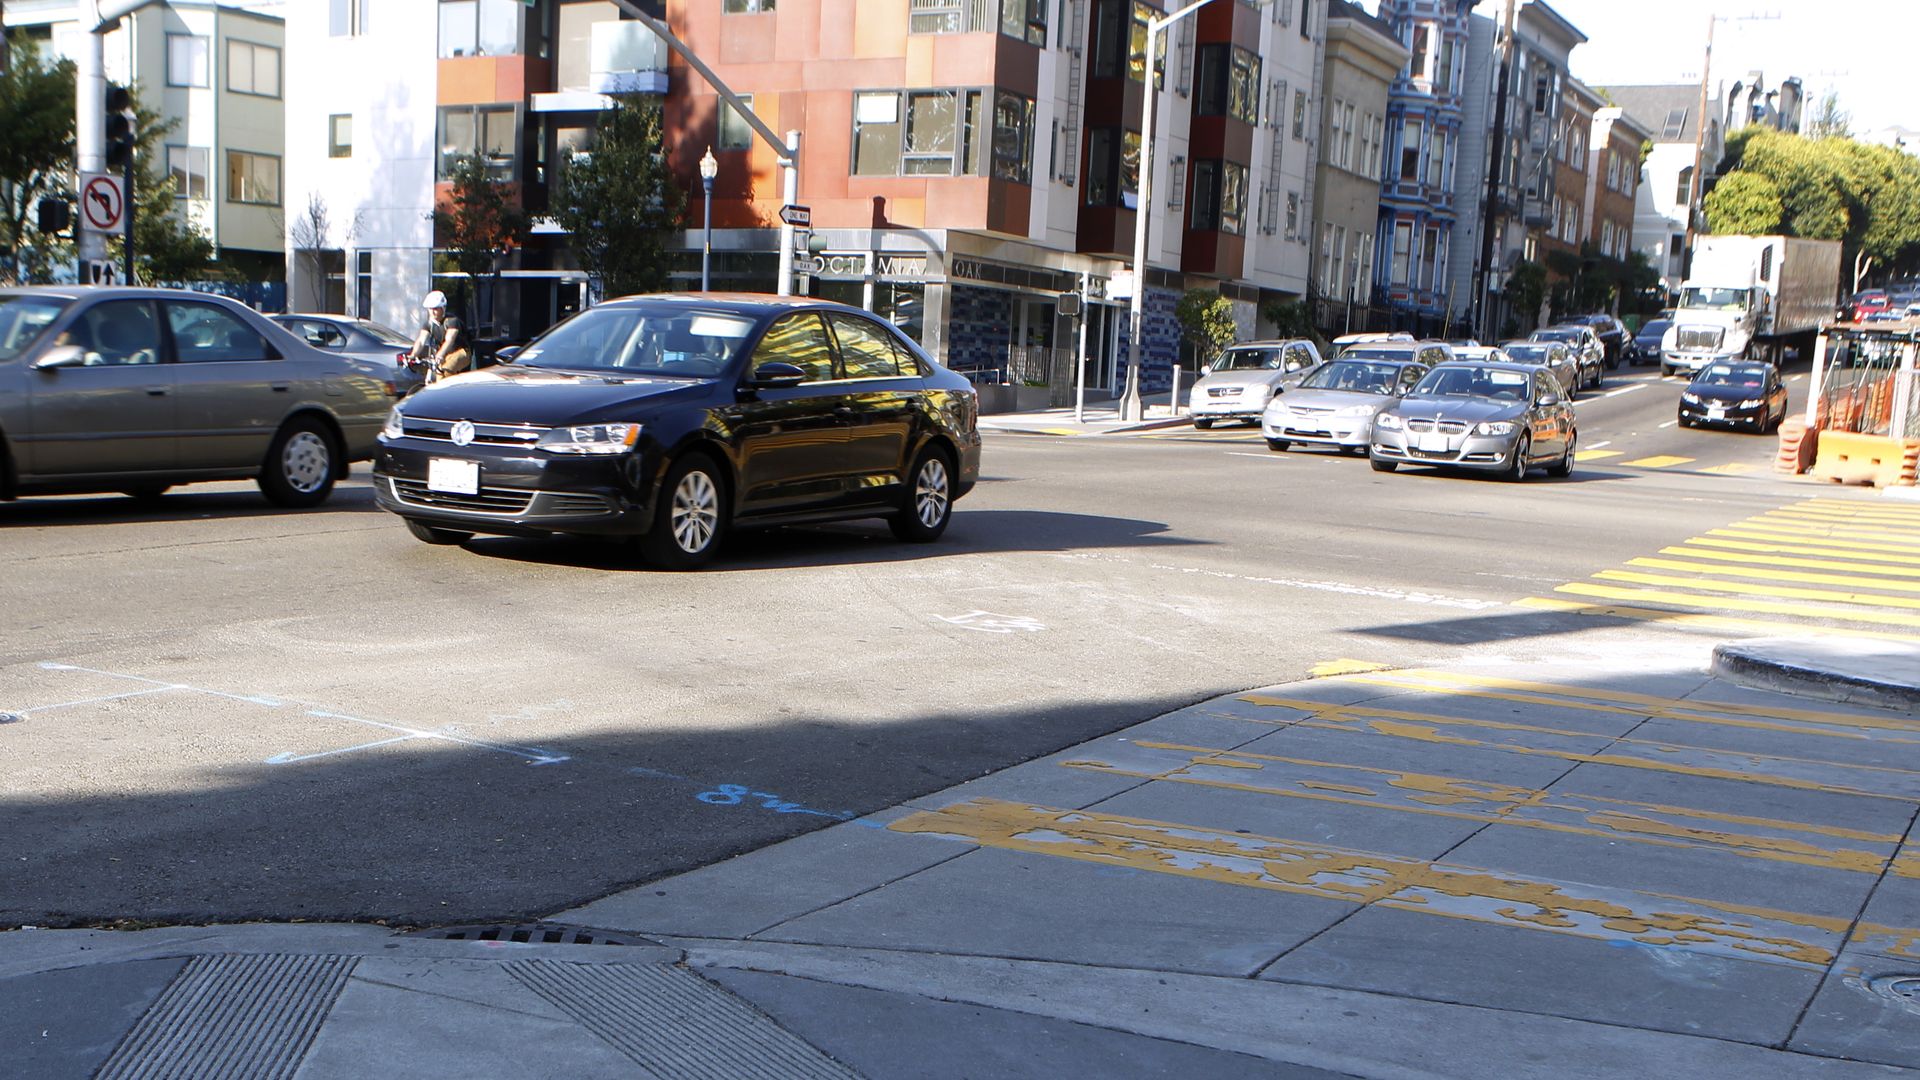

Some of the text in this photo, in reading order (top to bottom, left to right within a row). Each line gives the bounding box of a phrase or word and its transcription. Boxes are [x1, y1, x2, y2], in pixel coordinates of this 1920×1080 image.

[789, 211, 808, 220] ONE WAY
[955, 260, 982, 280] OAK
